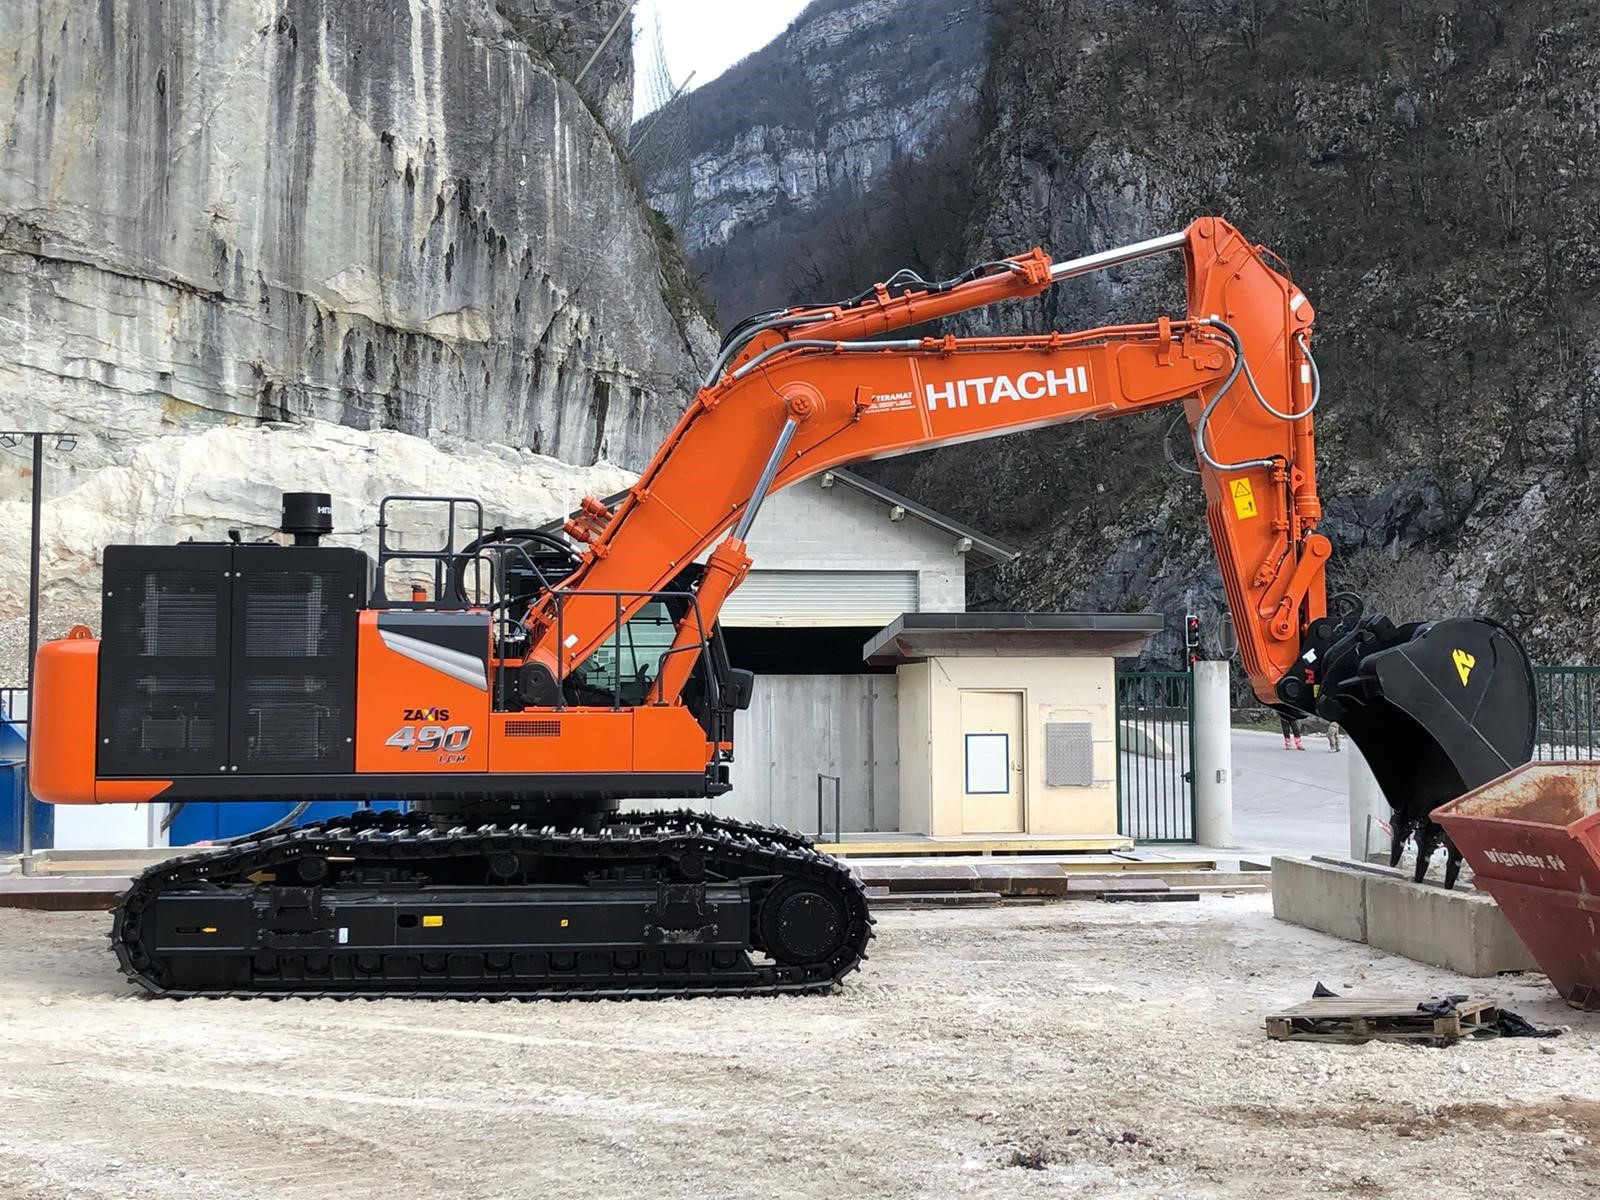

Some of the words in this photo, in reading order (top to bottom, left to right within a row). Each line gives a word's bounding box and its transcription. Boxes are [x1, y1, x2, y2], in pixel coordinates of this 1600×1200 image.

[926, 366, 1088, 411] HITACHI
[403, 708, 450, 721] ZAXIS
[385, 725, 473, 752] 490
[1483, 848, 1567, 872] vignier.fr
